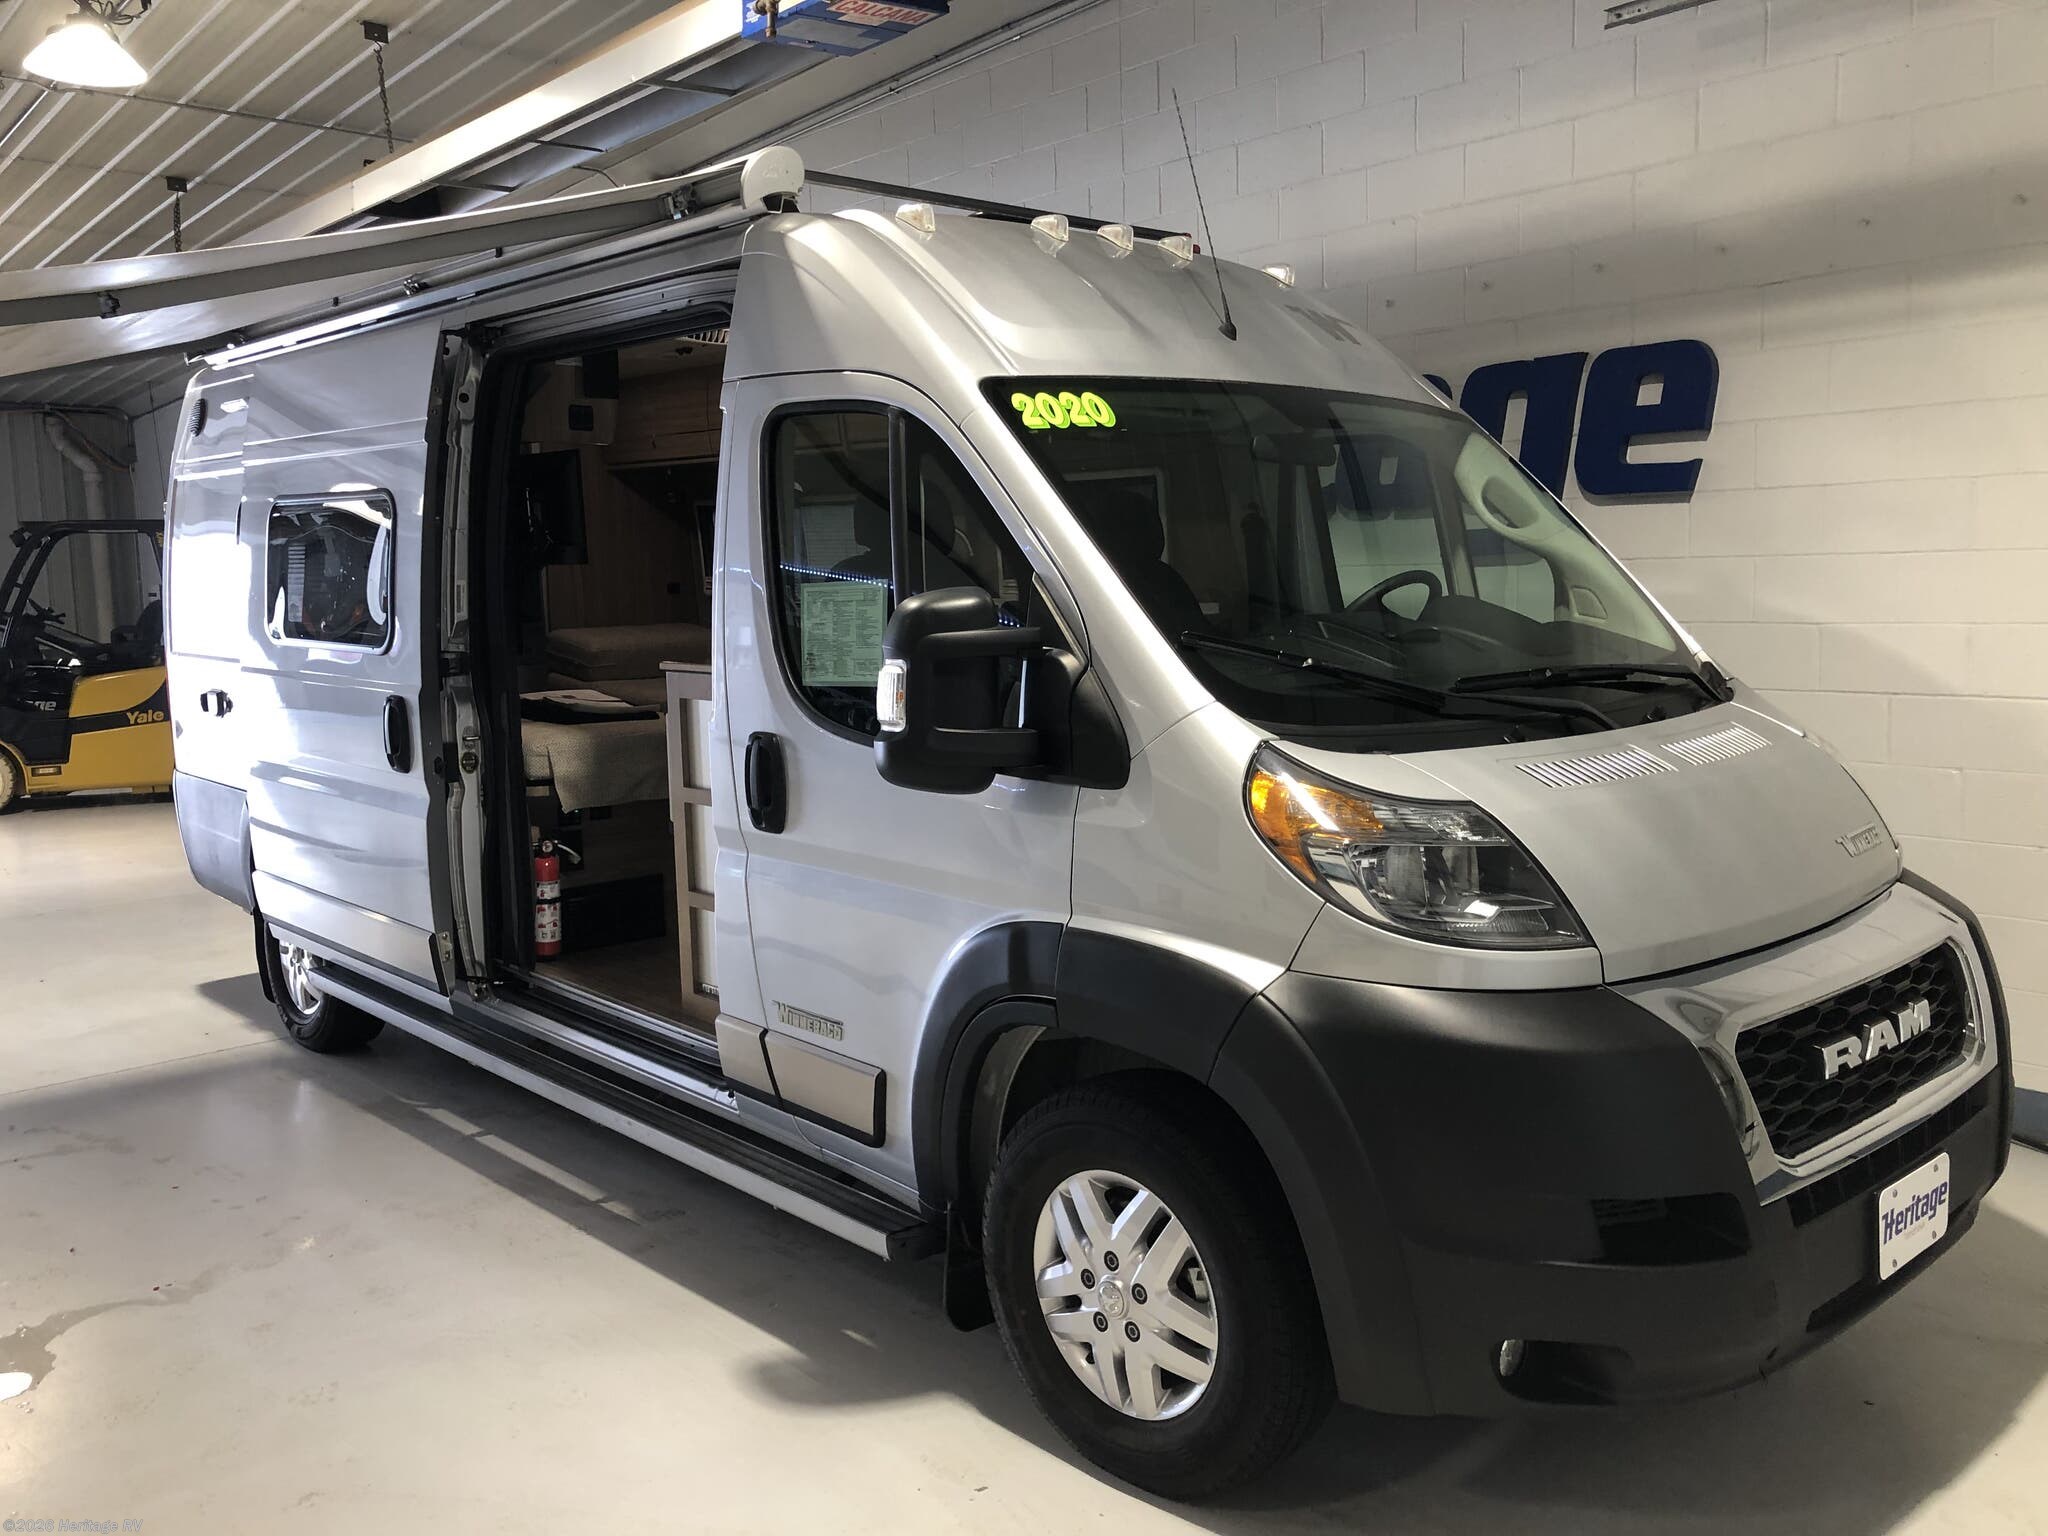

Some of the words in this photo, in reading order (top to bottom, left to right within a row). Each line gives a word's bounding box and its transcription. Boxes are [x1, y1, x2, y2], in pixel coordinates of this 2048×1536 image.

[1011, 391, 1116, 430] 2020
[126, 709, 165, 725] Yale
[1815, 999, 1931, 1080] RAM
[1882, 1181, 1948, 1245] Heritage
